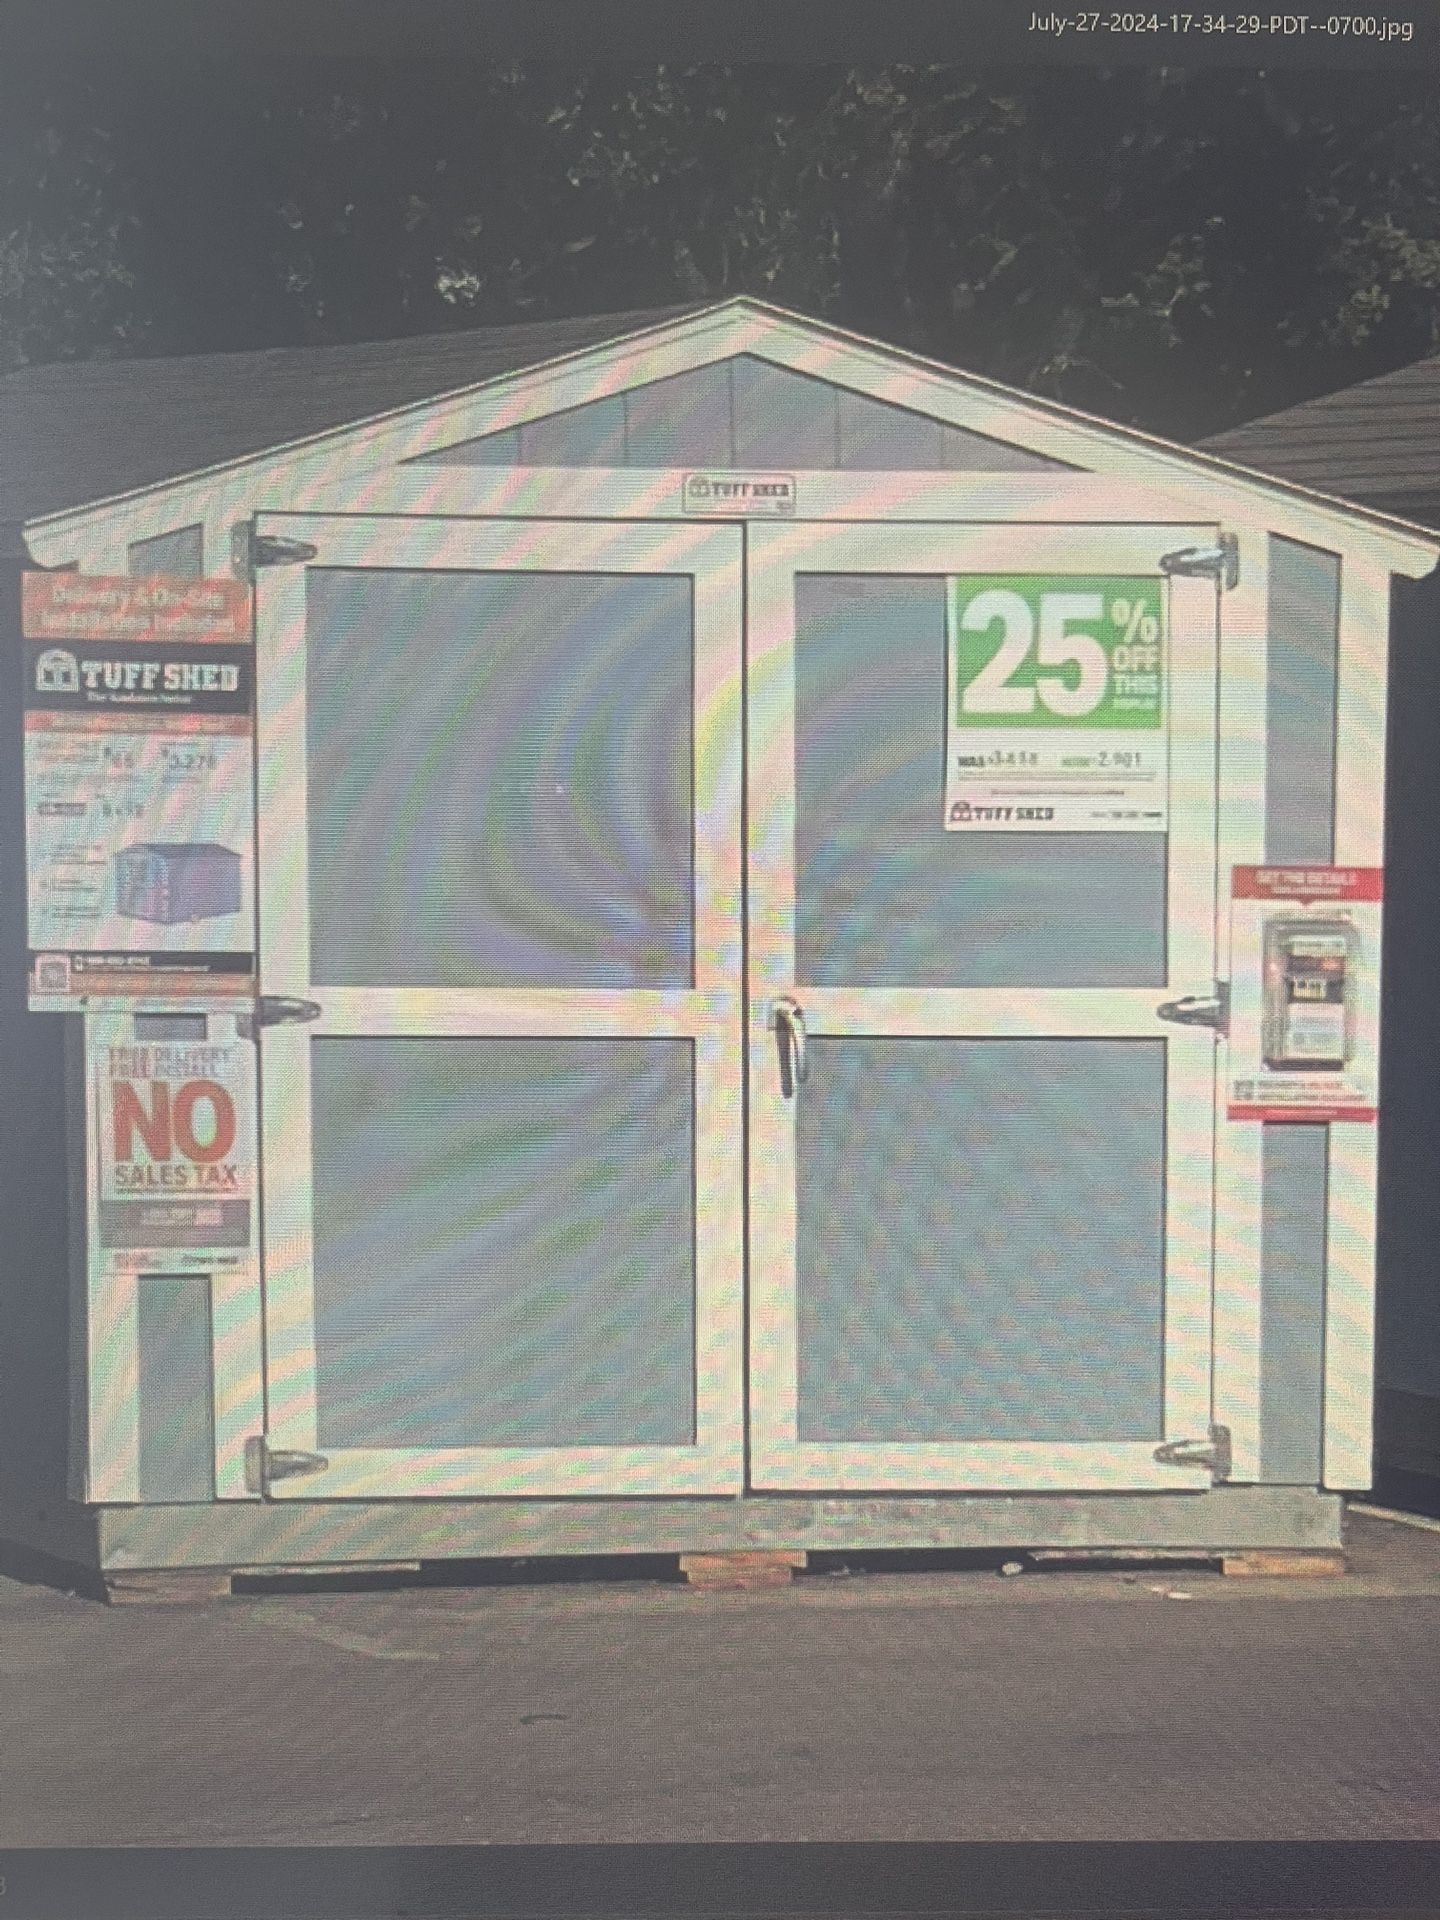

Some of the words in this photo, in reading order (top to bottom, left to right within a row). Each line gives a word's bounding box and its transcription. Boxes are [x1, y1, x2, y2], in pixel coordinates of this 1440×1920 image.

[1027, 12, 1414, 41] July-27-2024-17-34-29-PDT--0700.jpg
[712, 482, 750, 497] TUFF
[1112, 645, 1159, 672] OFF
[81, 660, 160, 690] TUFF
[163, 662, 240, 692] SHED
[973, 806, 1013, 821] TUFF
[154, 1047, 230, 1062] DELIVERY
[113, 1079, 236, 1163] NO
[115, 1164, 187, 1186] SALES
[194, 1165, 237, 1186] TAX
